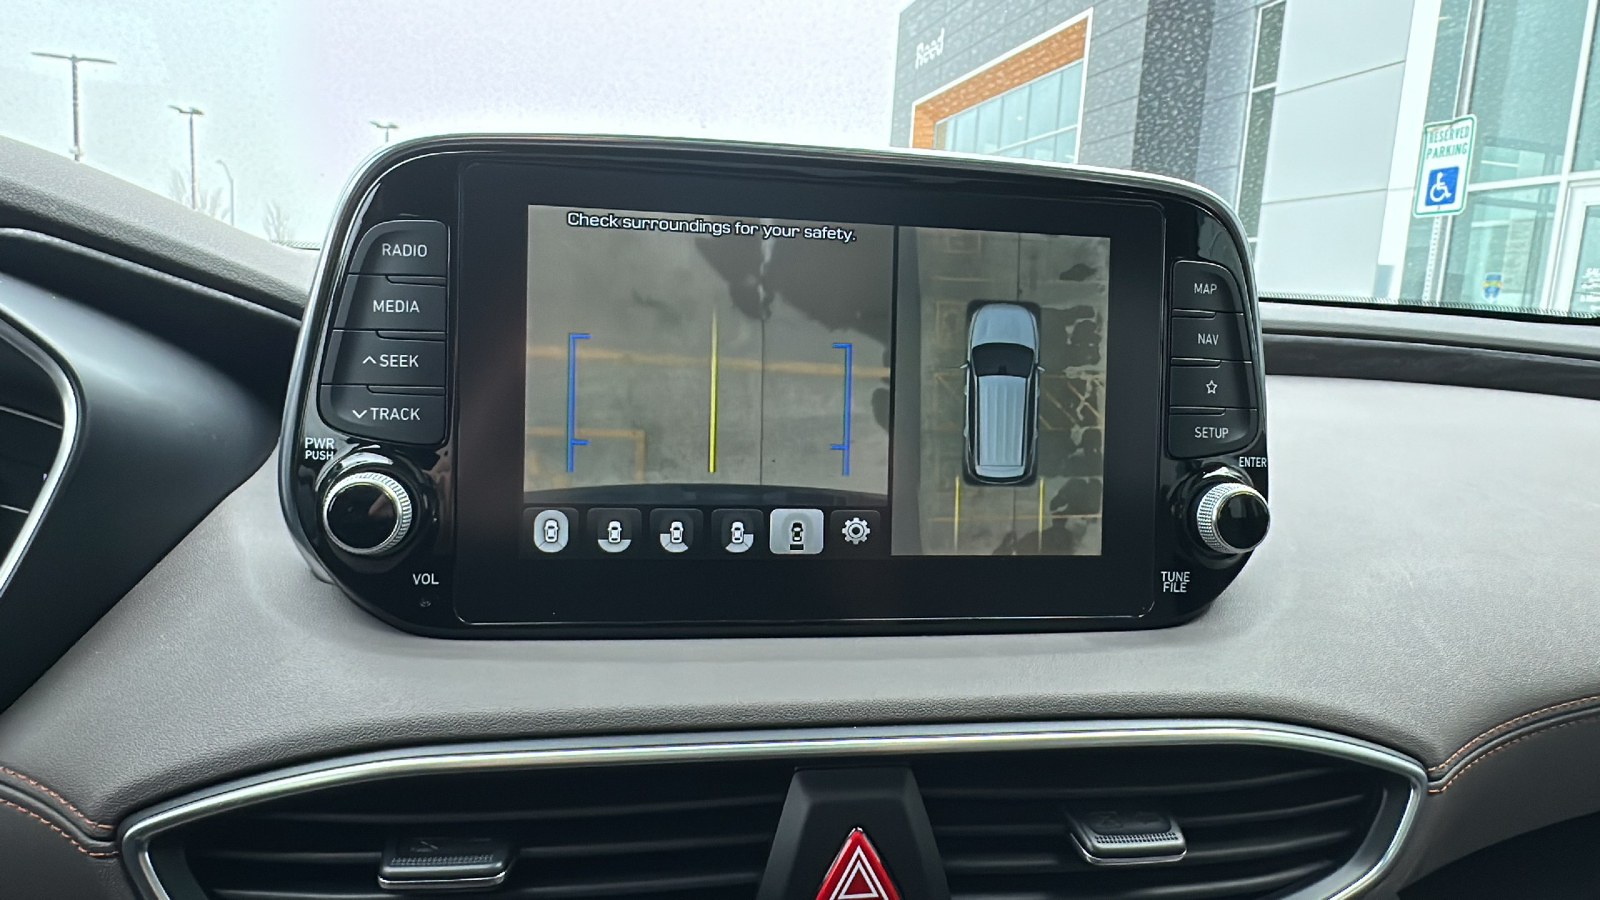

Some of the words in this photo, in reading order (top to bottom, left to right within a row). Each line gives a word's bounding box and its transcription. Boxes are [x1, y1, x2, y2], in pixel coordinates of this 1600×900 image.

[915, 27, 945, 69] Reed
[1428, 126, 1470, 144] RESERVED
[1426, 142, 1468, 160] PARKING
[567, 211, 619, 229] Check
[622, 215, 731, 236] surroundings
[734, 221, 759, 236] for
[761, 224, 800, 239] your
[803, 226, 857, 243] safety.
[381, 242, 428, 258] RADIO
[1194, 283, 1218, 295] MAP
[373, 299, 420, 314] MEDIA
[1197, 333, 1219, 345] NAV
[379, 354, 419, 369] SEEK
[370, 407, 421, 422] TRACK
[1194, 427, 1229, 439] SETUP
[304, 437, 335, 449] PWR
[305, 449, 334, 461] PUSH
[1239, 456, 1267, 468] ENTER
[412, 573, 440, 586] VOL
[1161, 571, 1191, 583] TUNE
[1163, 582, 1187, 593] FILE
